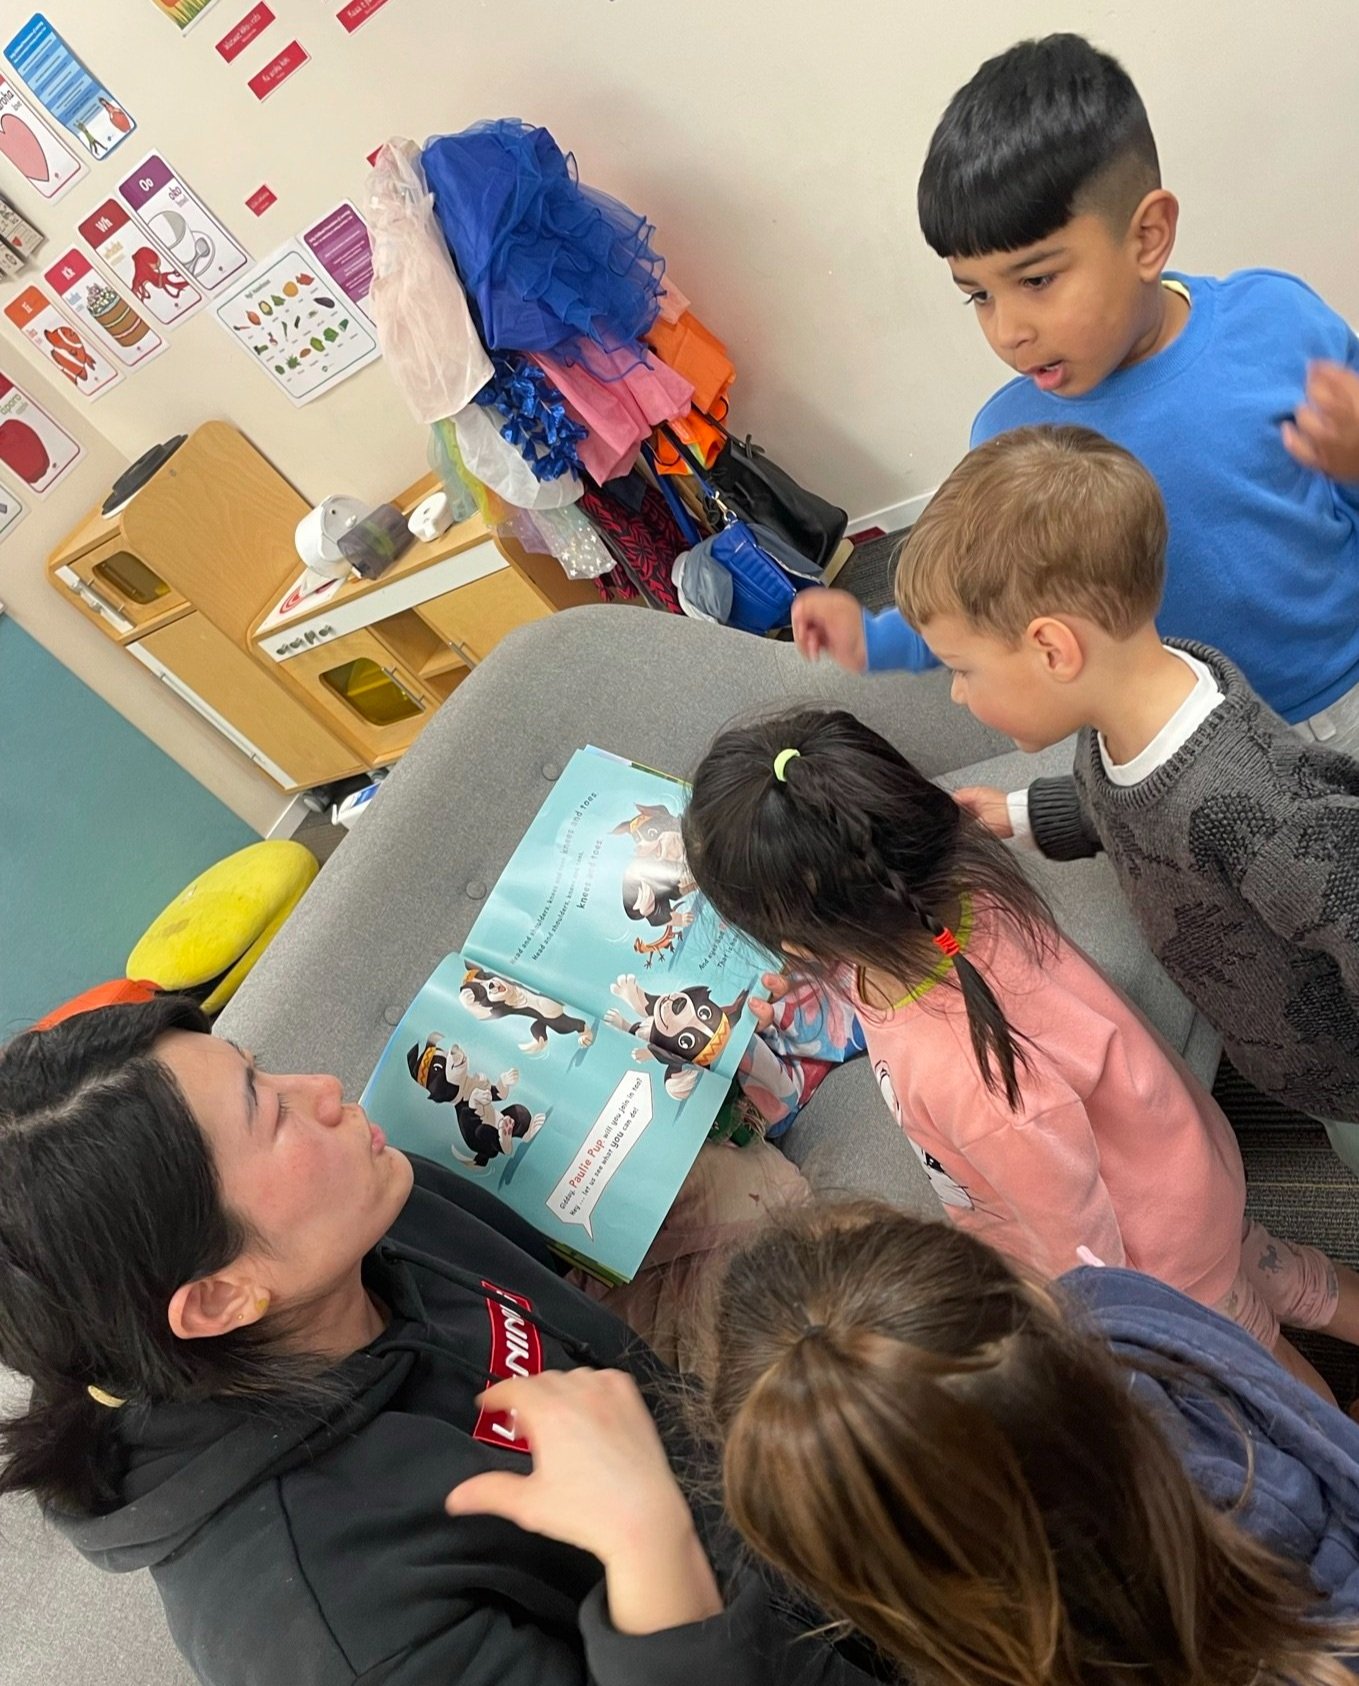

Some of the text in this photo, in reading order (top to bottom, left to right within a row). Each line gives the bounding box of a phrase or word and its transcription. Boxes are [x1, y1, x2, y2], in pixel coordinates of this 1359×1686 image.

[139, 178, 154, 191] Oo
[96, 216, 113, 232] Wh
[576, 883, 591, 909] knees
[522, 936, 532, 949] and
[532, 944, 546, 961] Head
[544, 932, 554, 945] and
[699, 958, 710, 970] And
[569, 1160, 591, 1188] Paulie
[603, 1126, 613, 1138] will
[611, 1113, 622, 1126] you
[619, 1100, 629, 1114] join
[627, 1092, 635, 1100] in
[632, 1077, 643, 1091] too?
[570, 1205, 581, 1216] Hey
[582, 1186, 591, 1195] let
[589, 1177, 596, 1185] us
[595, 1166, 603, 1176] see
[602, 1149, 613, 1165] what
[611, 1132, 624, 1148] you
[623, 1120, 632, 1131] can
[630, 1107, 639, 1118] do!
